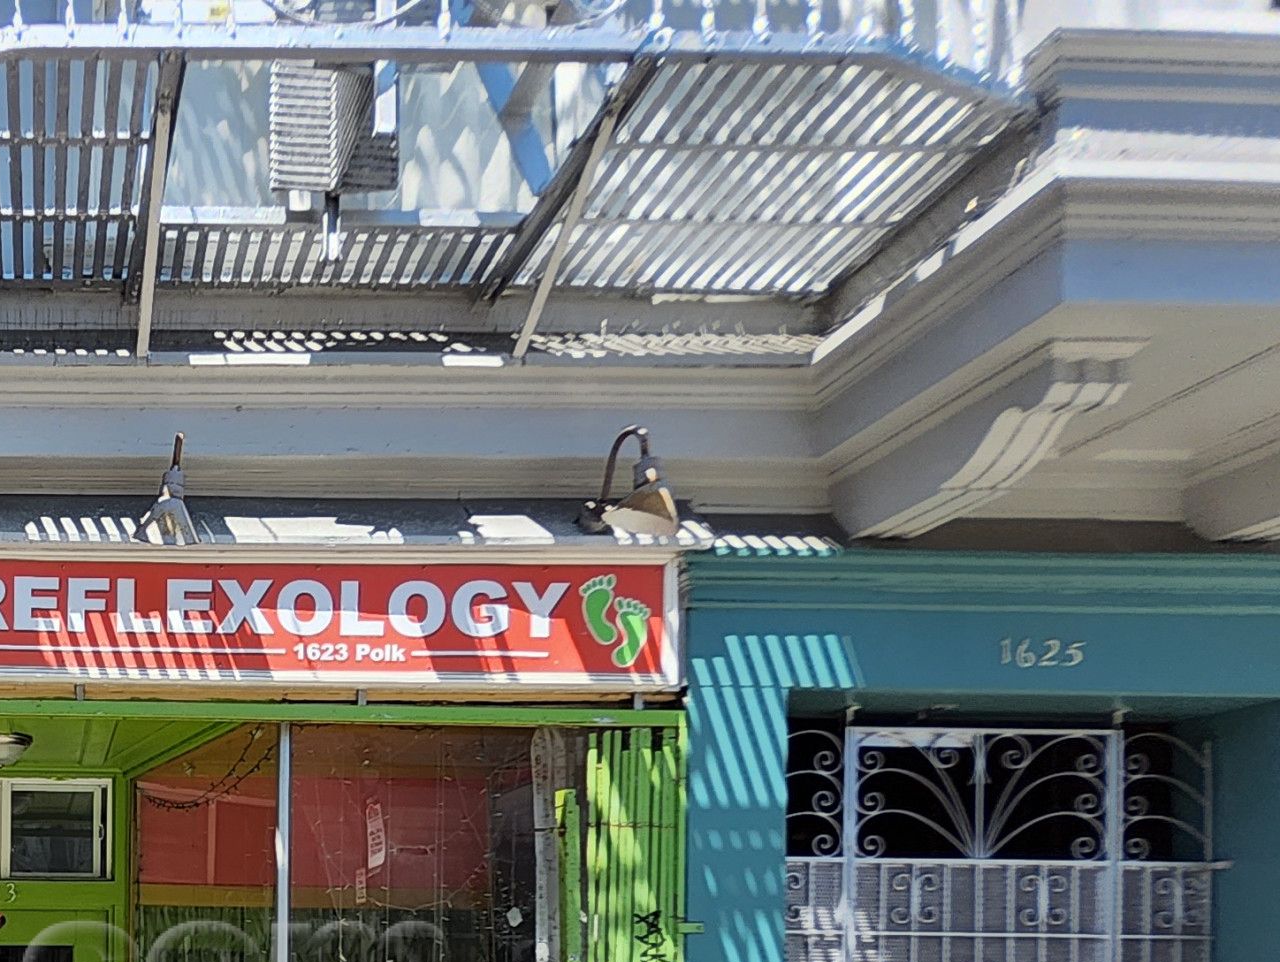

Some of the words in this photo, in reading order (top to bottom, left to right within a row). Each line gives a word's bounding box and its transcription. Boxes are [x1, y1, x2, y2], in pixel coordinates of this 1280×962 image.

[294, 643, 351, 662] 1623
[355, 643, 406, 662] Polk
[1001, 638, 1087, 668] 1625
